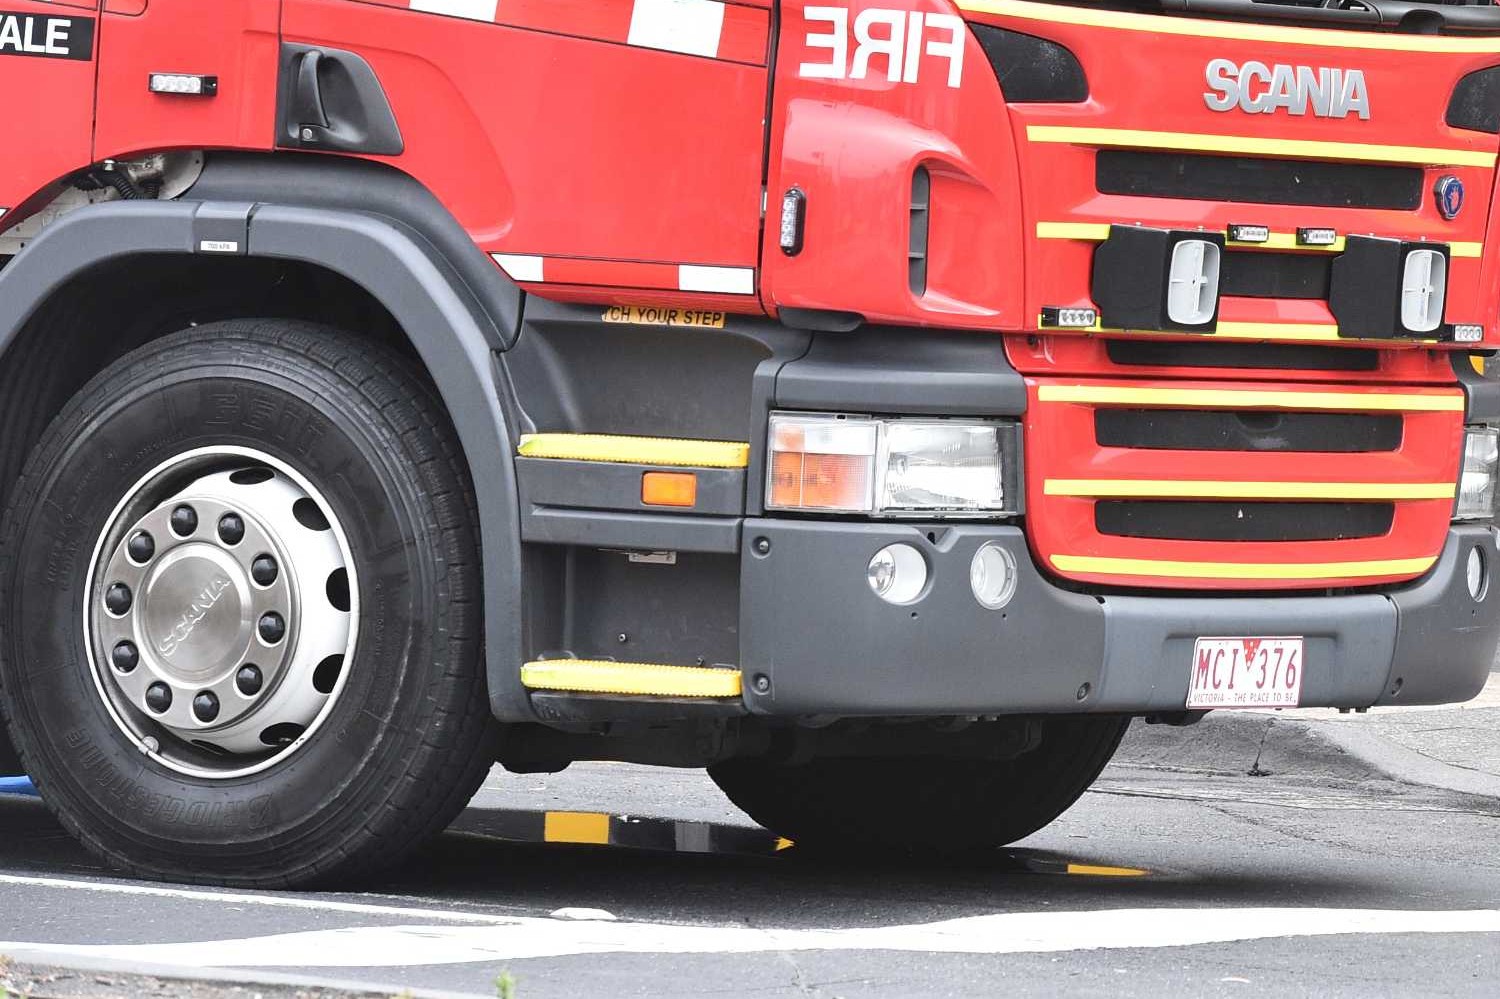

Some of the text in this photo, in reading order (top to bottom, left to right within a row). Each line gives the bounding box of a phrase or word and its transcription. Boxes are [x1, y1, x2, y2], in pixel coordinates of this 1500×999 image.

[0, 14, 72, 55] ALE
[1203, 58, 1370, 120] SCANIA
[638, 308, 678, 324] YOUR
[683, 310, 721, 325] STEP
[1256, 648, 1297, 689] 376
